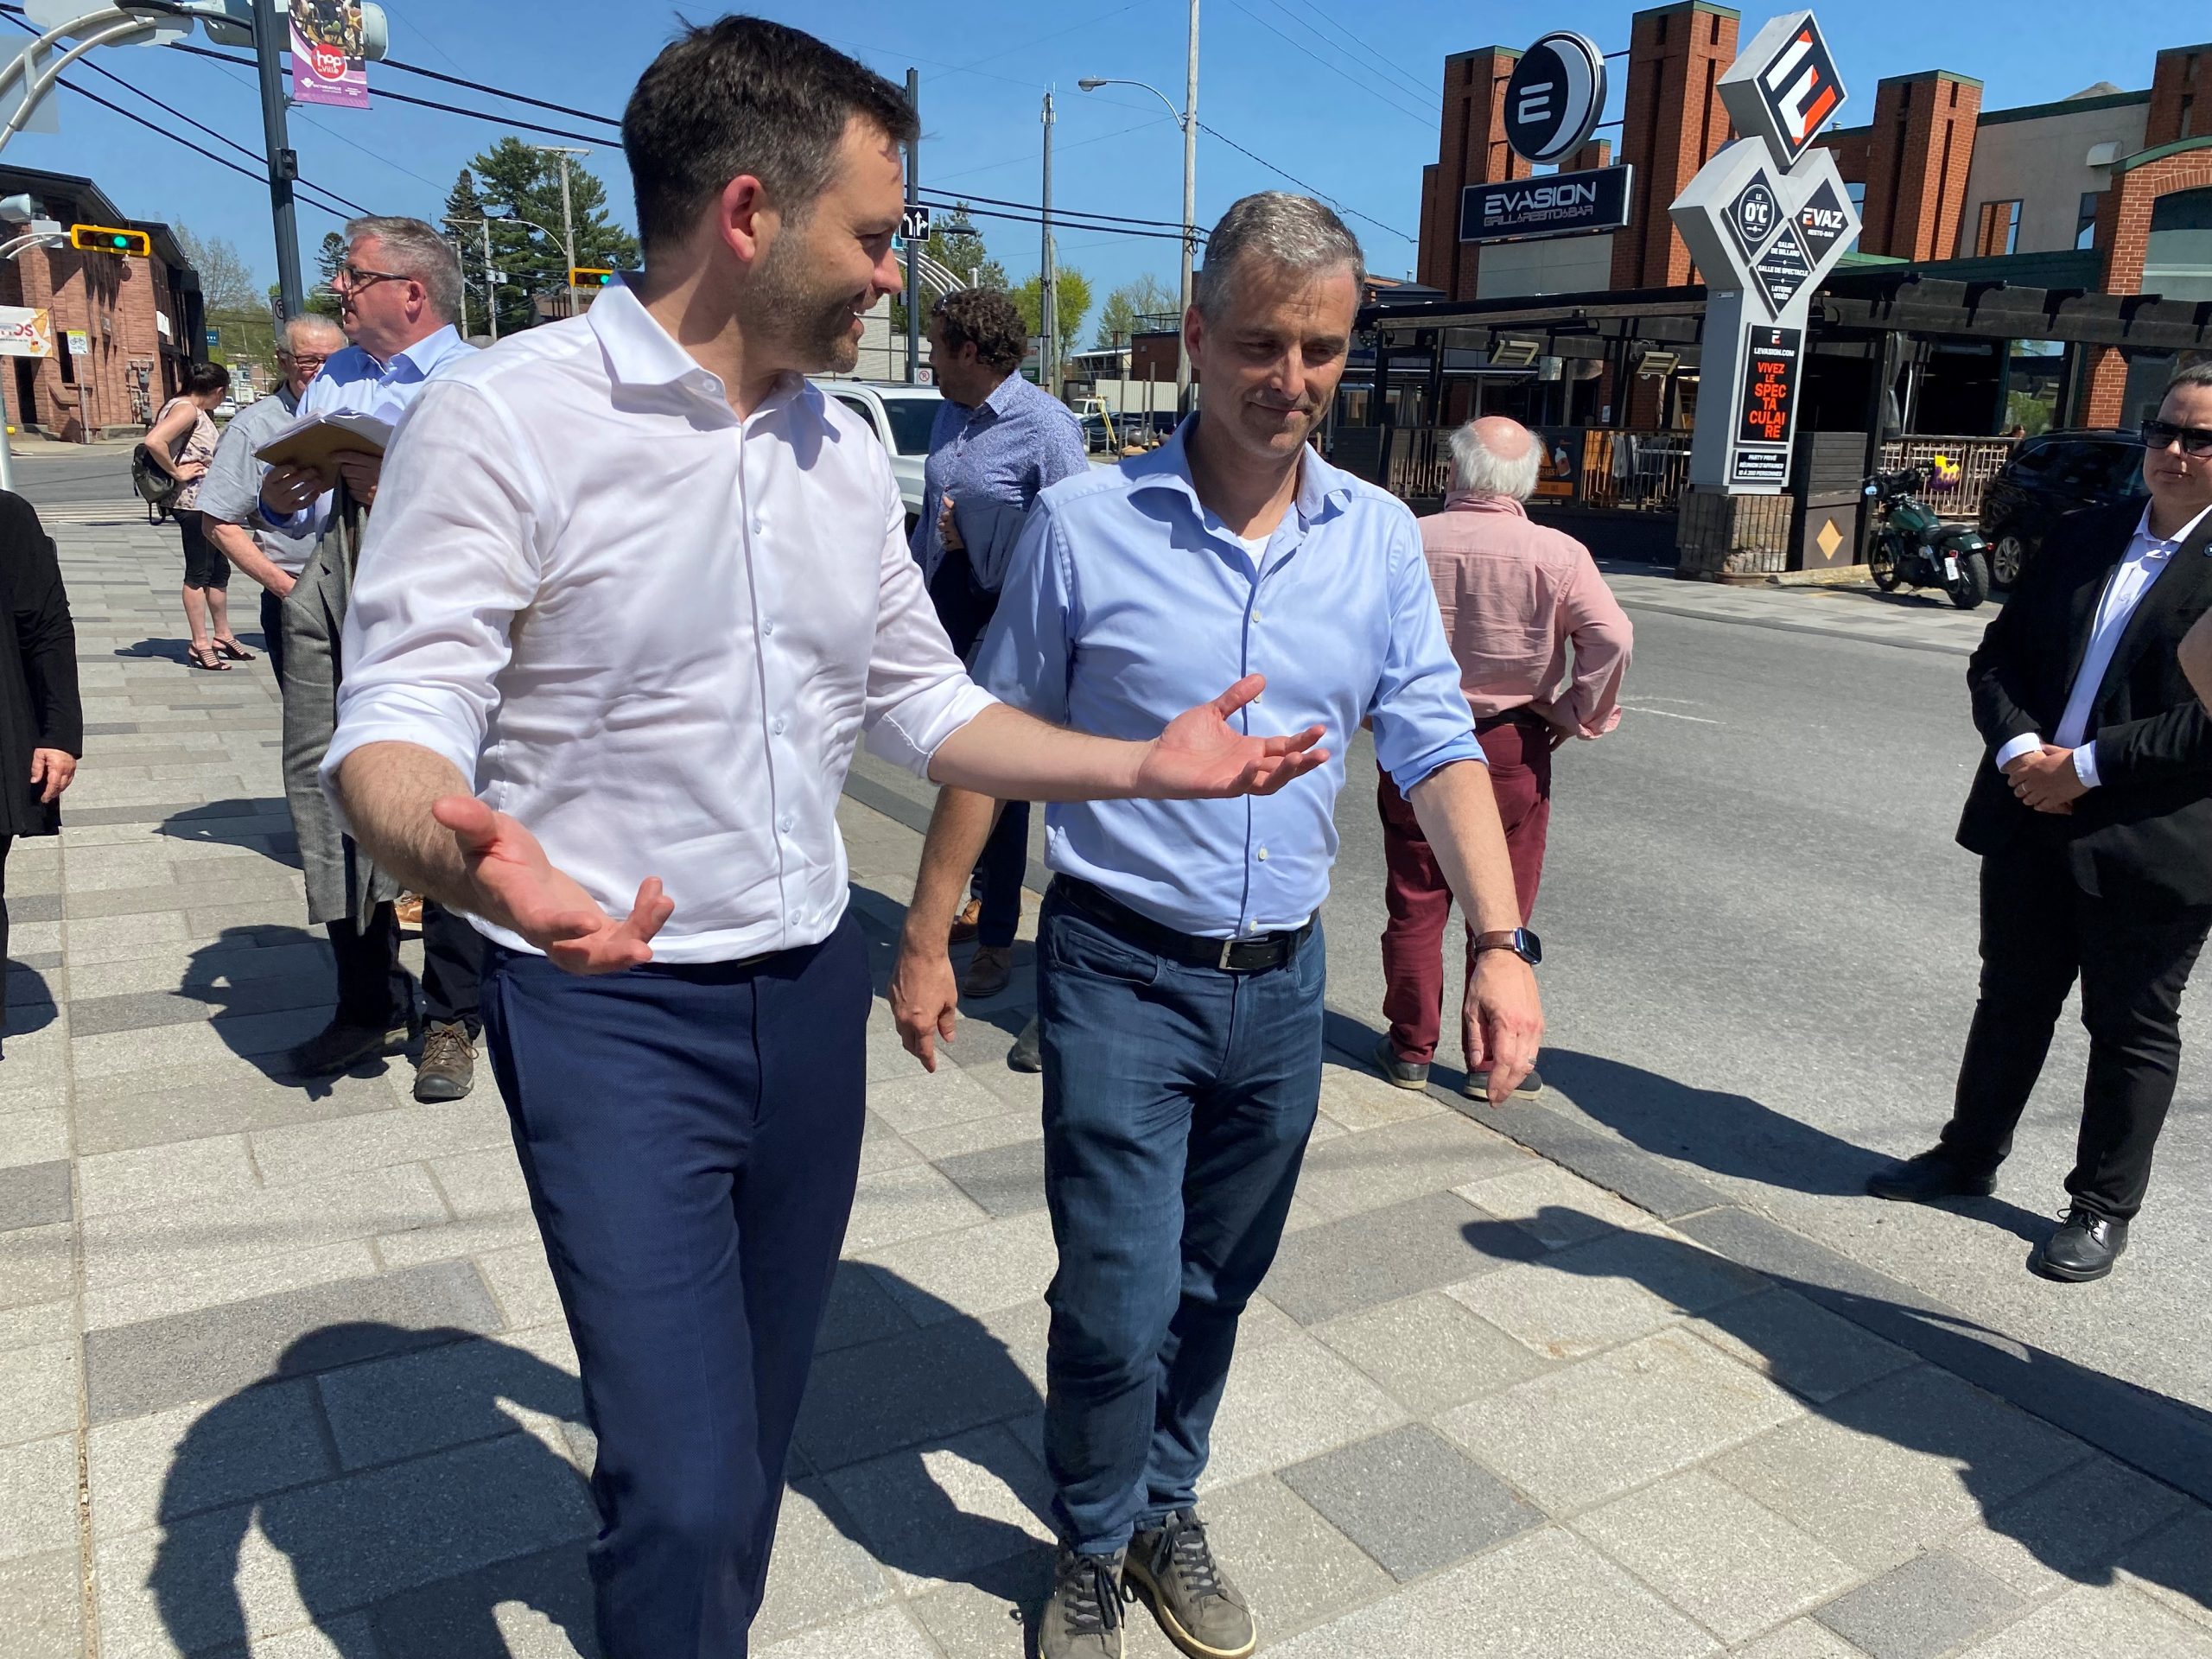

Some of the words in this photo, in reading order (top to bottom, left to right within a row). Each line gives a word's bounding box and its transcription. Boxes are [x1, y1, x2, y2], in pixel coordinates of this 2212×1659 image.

[316, 50, 341, 68] hop
[1484, 181, 1597, 215] EVASION
[1745, 202, 1768, 224] O'C
[1802, 207, 1843, 229] EVAZ
[1778, 248, 1800, 257] BILLARD
[1782, 267, 1808, 276] SPECTACLE
[1753, 347, 1795, 357] LEVASION.COM
[1758, 362, 1785, 374] VIVEZ
[1765, 374, 1775, 383] LE
[1754, 383, 1787, 398] SPEC
[1762, 397, 1777, 410] TA
[1749, 410, 1786, 425] CULAI
[1764, 424, 1781, 438] RE
